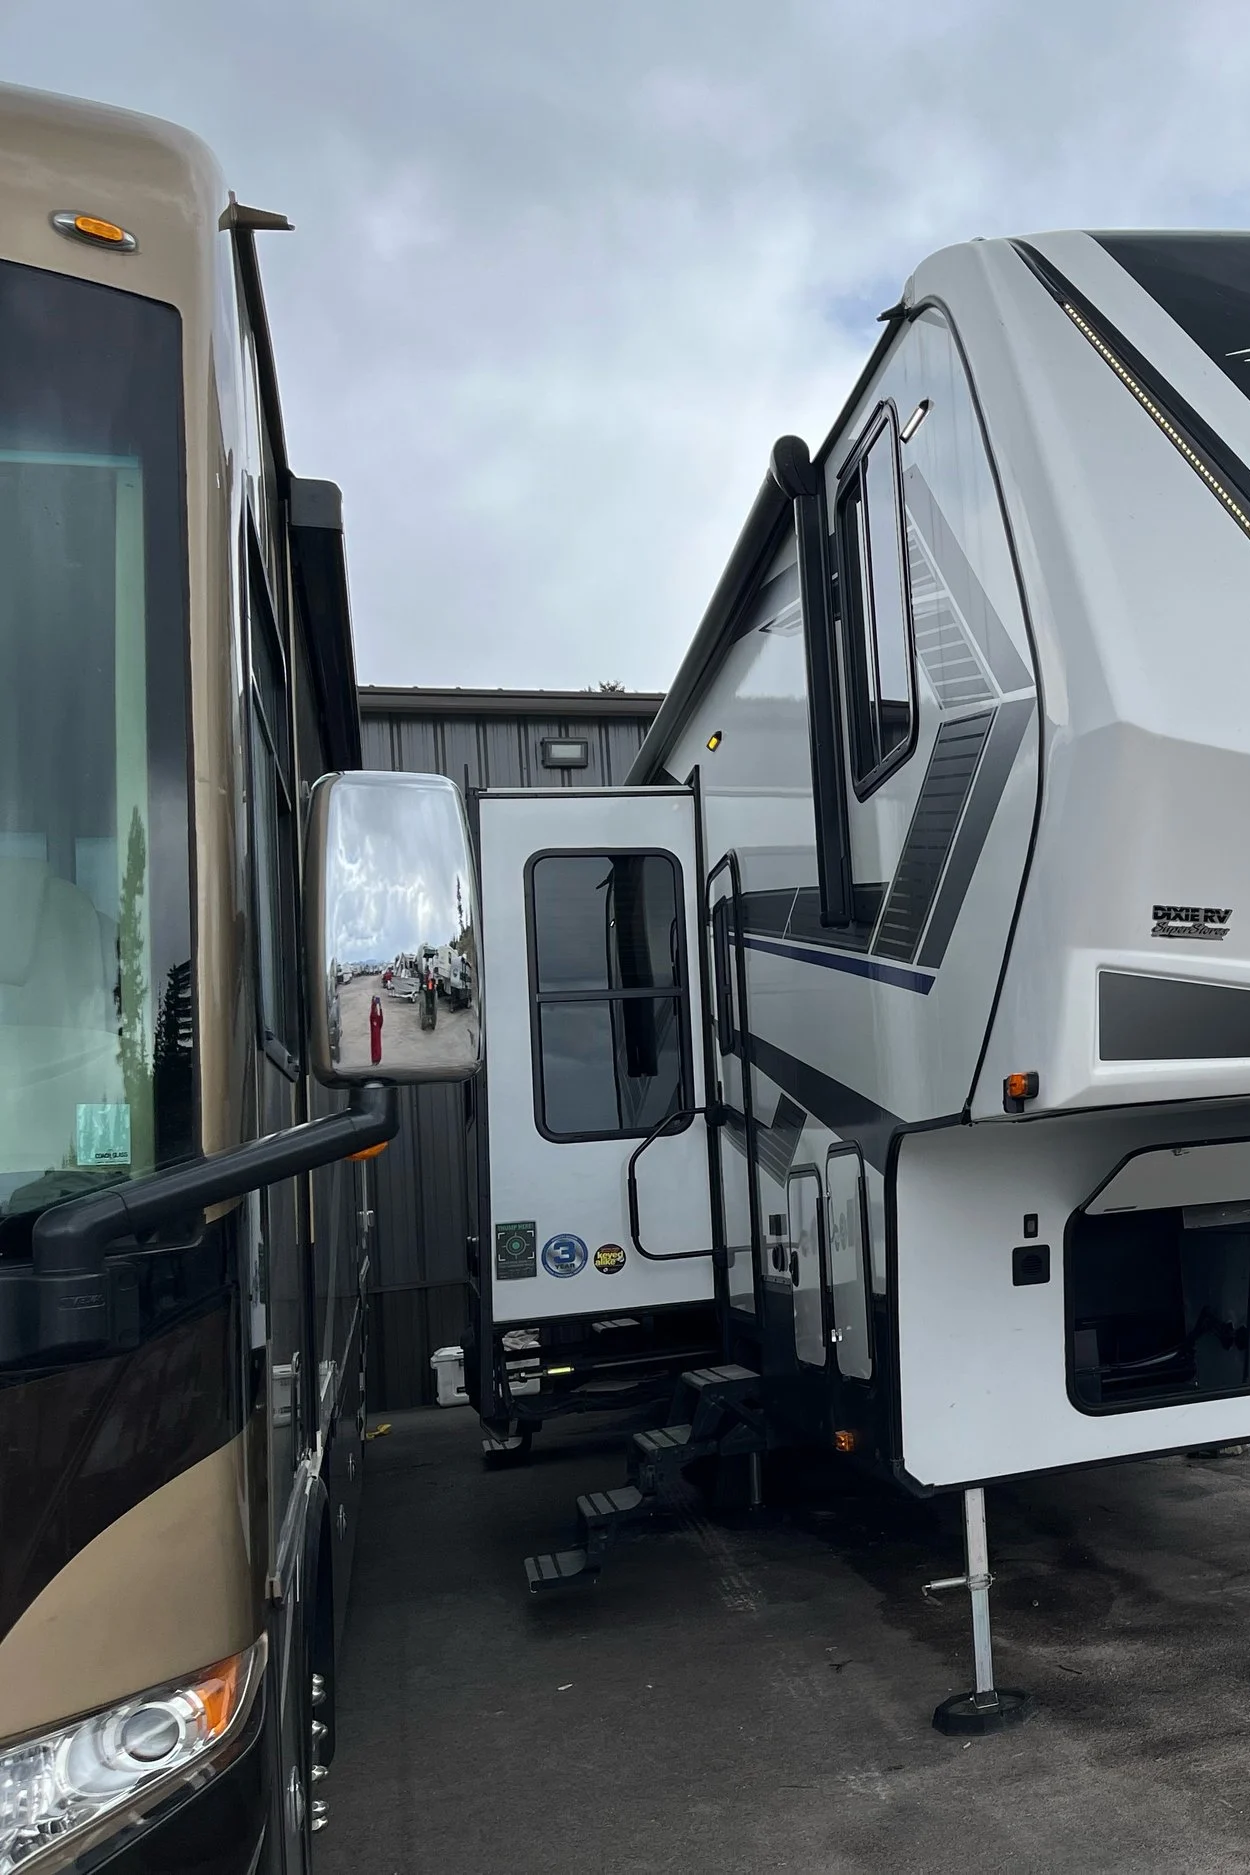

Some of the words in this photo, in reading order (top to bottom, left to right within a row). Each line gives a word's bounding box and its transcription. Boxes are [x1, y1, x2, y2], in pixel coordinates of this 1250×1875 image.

[1153, 905, 1200, 921] DIXIE
[1203, 907, 1233, 924] RV
[1151, 921, 1230, 936] SuperStores
[553, 1241, 576, 1262] 3
[597, 1250, 624, 1261] keyed
